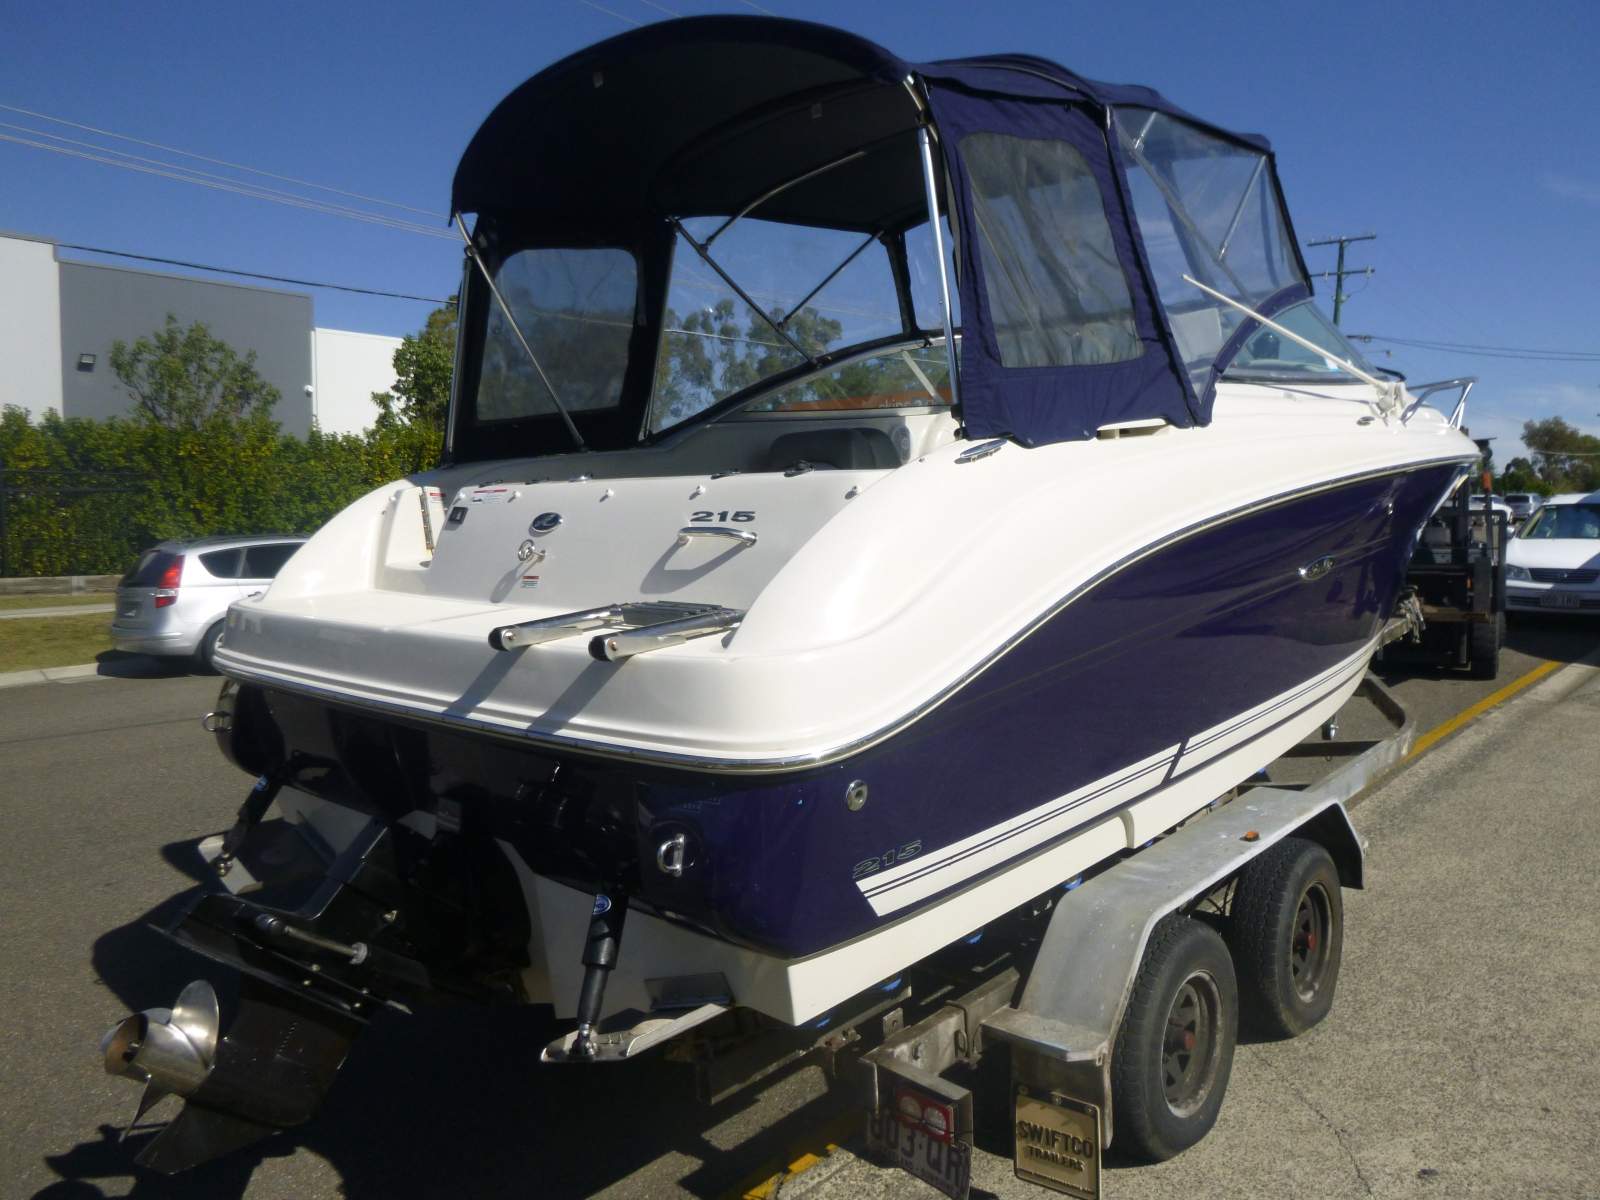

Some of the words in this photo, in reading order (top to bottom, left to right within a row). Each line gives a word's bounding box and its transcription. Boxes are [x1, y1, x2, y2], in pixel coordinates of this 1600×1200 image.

[690, 510, 756, 522] 215
[852, 839, 922, 879] 215
[1017, 1119, 1094, 1159] SWIFTCO
[1026, 1144, 1086, 1173] TRAILERS
